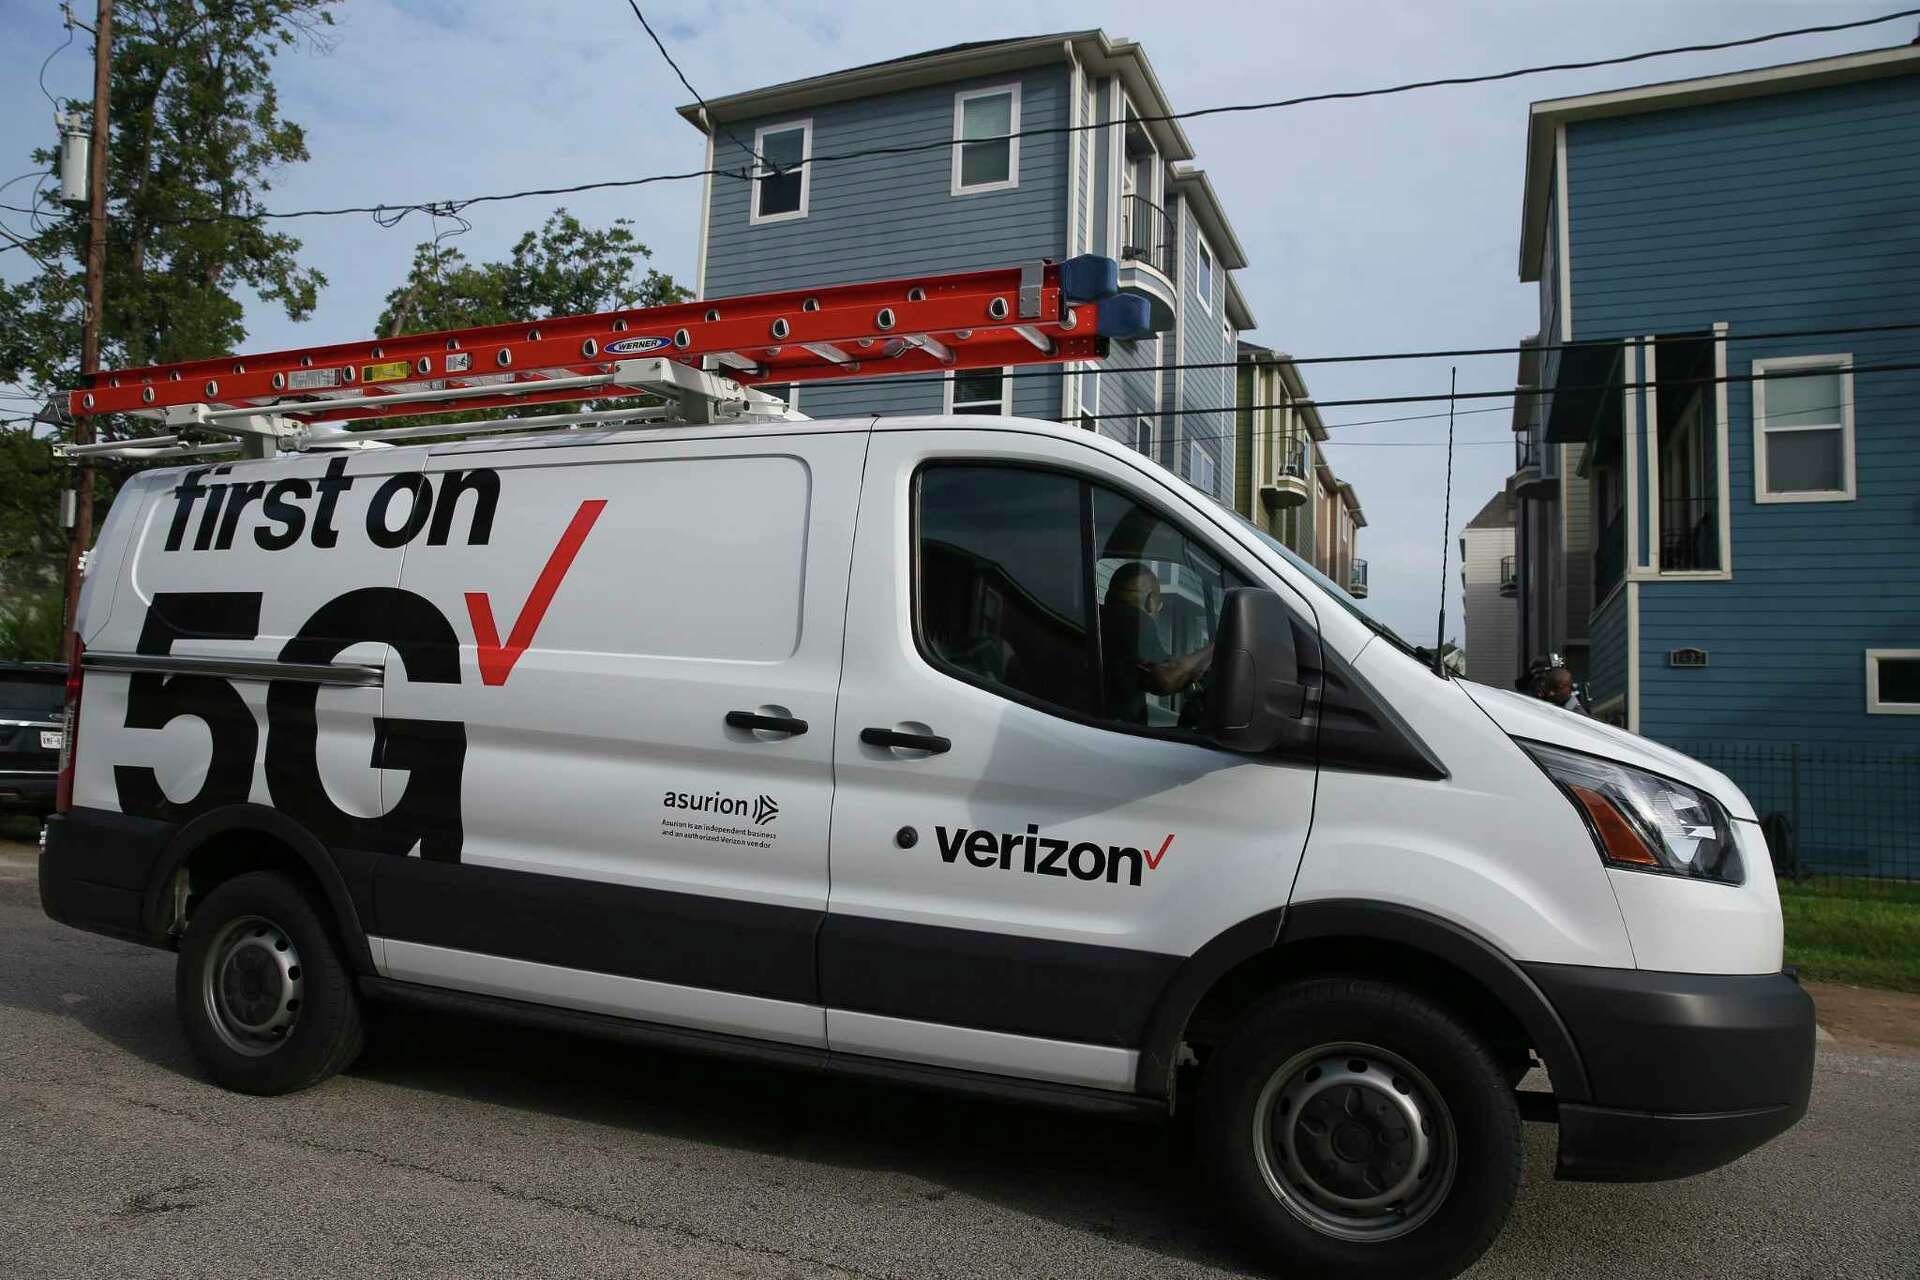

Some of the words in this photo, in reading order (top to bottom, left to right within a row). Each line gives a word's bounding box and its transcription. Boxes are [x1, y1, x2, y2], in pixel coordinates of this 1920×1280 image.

[618, 339, 658, 351] WERNER
[164, 456, 354, 552] first
[366, 468, 501, 550] on
[114, 587, 467, 864] 5G
[663, 791, 748, 816] asurion
[662, 819, 686, 829] Asurion
[704, 824, 746, 836] independent
[748, 829, 776, 839] business
[684, 833, 720, 842] authorized
[720, 837, 746, 846] Verizon
[935, 824, 1143, 887] verizon
